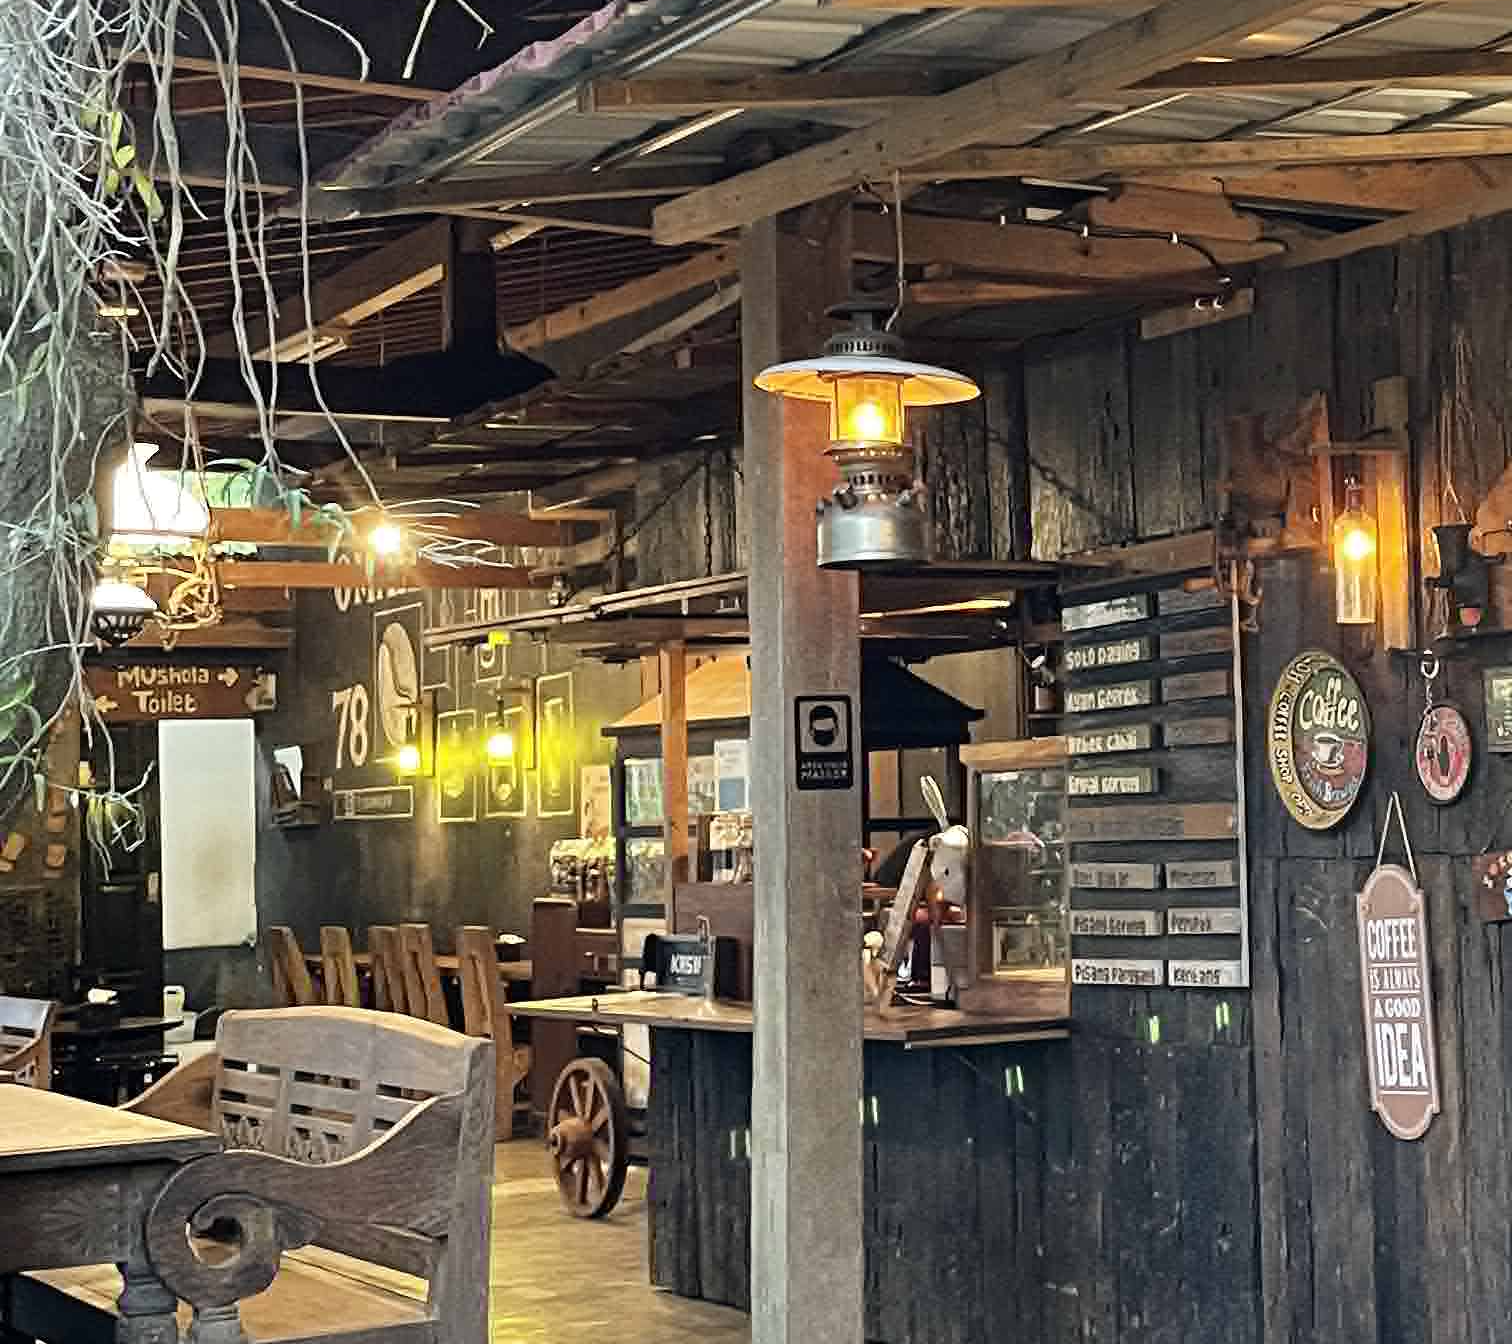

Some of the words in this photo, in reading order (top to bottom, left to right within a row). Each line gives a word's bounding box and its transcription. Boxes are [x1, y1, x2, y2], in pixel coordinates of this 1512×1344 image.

[131, 690, 200, 714] Toilet
[332, 683, 369, 769] 78
[1366, 918, 1417, 961] COFFEE
[1384, 968, 1421, 988] ALWAYS
[1375, 998, 1385, 1017] A
[1385, 998, 1421, 1017] GOOD
[1375, 1023, 1429, 1088] IDEA
